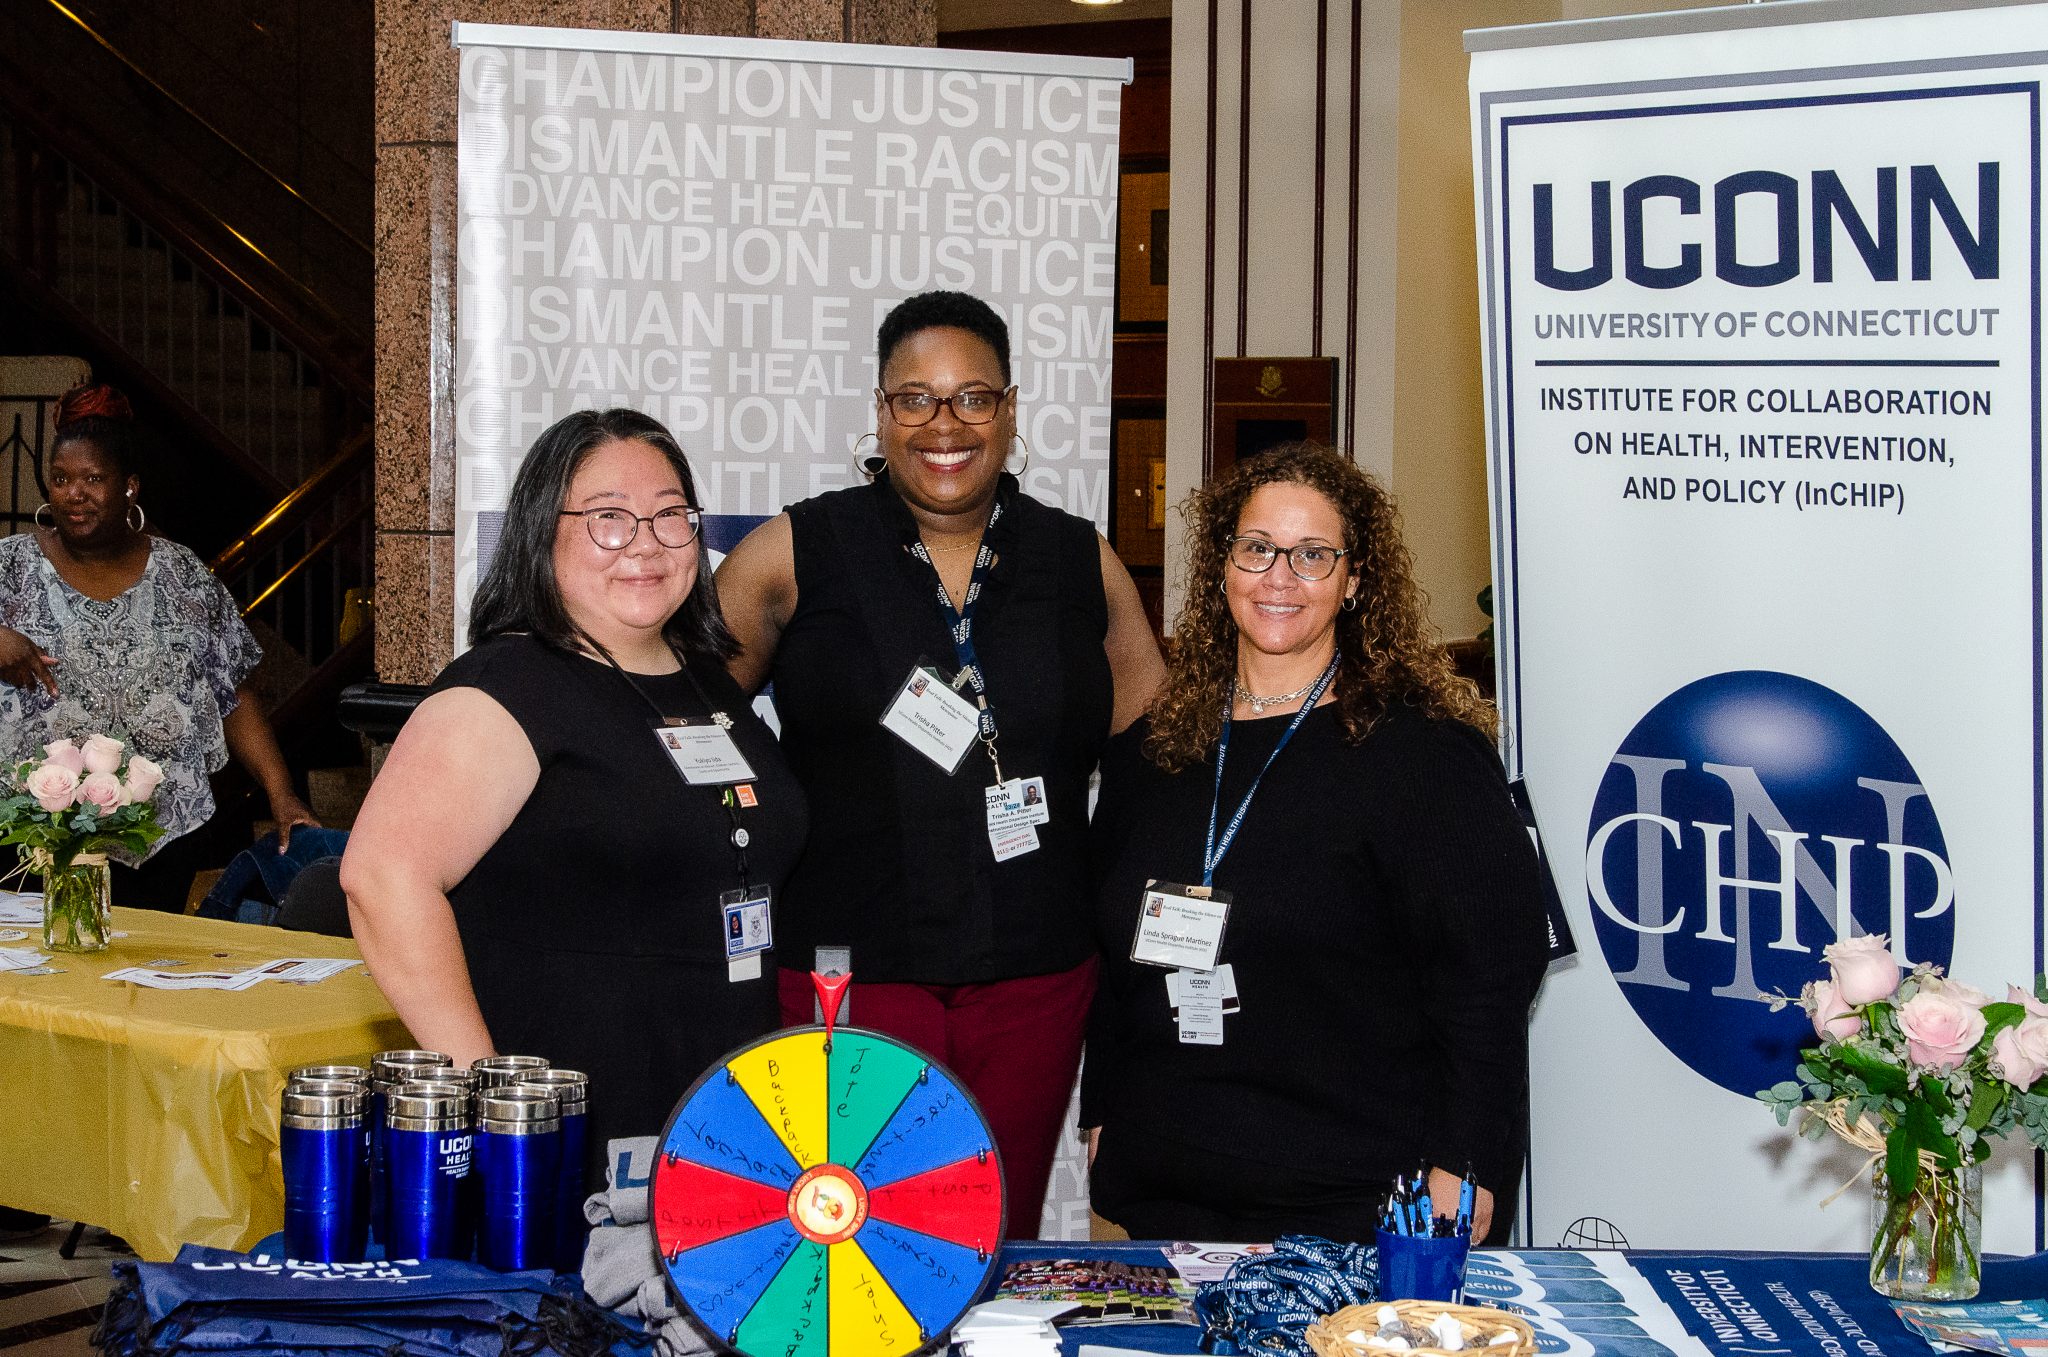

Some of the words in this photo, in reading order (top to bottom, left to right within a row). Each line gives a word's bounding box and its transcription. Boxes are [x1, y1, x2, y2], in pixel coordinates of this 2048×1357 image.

[459, 45, 832, 120] CHAMPION
[852, 69, 1120, 134] JUSTICE
[460, 112, 853, 185] DISMANTLE
[876, 133, 1120, 197] RACISM
[731, 184, 928, 233] HEALTH
[944, 195, 1118, 240] EQUITY
[1533, 162, 2000, 292] UCONN
[458, 219, 830, 287] CHAMPION
[849, 236, 1117, 297] JUSTICE
[461, 285, 851, 353] DISMANTLE
[1534, 312, 1709, 340] UNIVERSITY
[1714, 311, 1758, 338] OF
[1765, 308, 2000, 338] CONNECTICUT
[1540, 386, 1674, 413] INSTITUTE
[1682, 388, 1737, 414] FOR
[1746, 388, 1992, 417] COLLABORATION
[1573, 430, 1612, 456] ON
[1621, 432, 1730, 463] HEALTH,
[1739, 434, 1956, 468] INTERVENTION,
[1622, 476, 1677, 501] AND
[1685, 478, 1787, 505] POLICY
[1795, 480, 1906, 516] (InCHIP)
[914, 711, 930, 727] Trisha
[929, 721, 946, 738] Pitter
[985, 792, 1010, 804] CONN
[1221, 818, 1241, 847] HEALTH
[1585, 812, 1956, 970] CHIP
[1143, 929, 1160, 938] Linda
[1161, 932, 1185, 943] Sprague
[1277, 1313, 1309, 1323] UCONN
